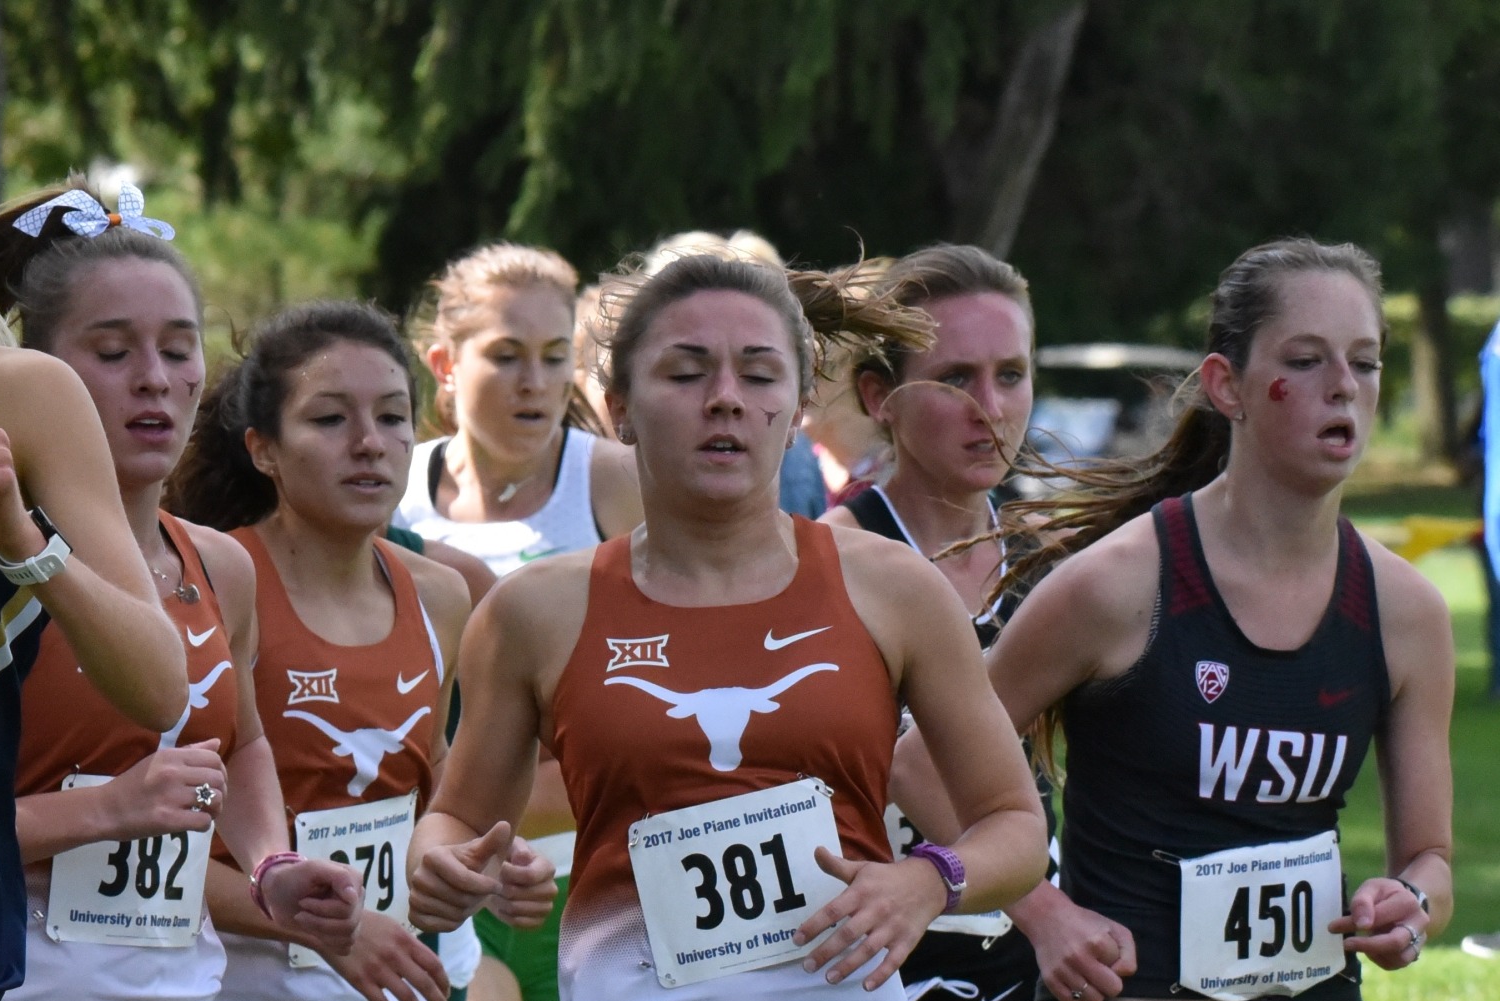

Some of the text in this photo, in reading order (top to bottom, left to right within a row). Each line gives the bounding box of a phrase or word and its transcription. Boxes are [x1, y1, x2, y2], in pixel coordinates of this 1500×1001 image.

[1199, 664, 1228, 686] PAC
[1203, 680, 1219, 695] 12
[1199, 722, 1348, 803] WSU
[307, 828, 330, 841] 2017
[332, 825, 347, 838] Joe
[349, 822, 372, 834] Piane
[642, 796, 817, 848] 2017 Joe Piane Invitational
[97, 830, 189, 900] 382
[330, 841, 393, 911] 79
[1196, 849, 1332, 877] 2017 Joe Piane Invitational
[681, 833, 806, 930] 381
[69, 909, 132, 928] University
[135, 914, 147, 927] of
[150, 914, 171, 927] Notre
[1224, 880, 1313, 960] 450
[676, 941, 742, 966] University
[746, 935, 759, 949] of
[1200, 966, 1331, 990] University of Notre Dame
